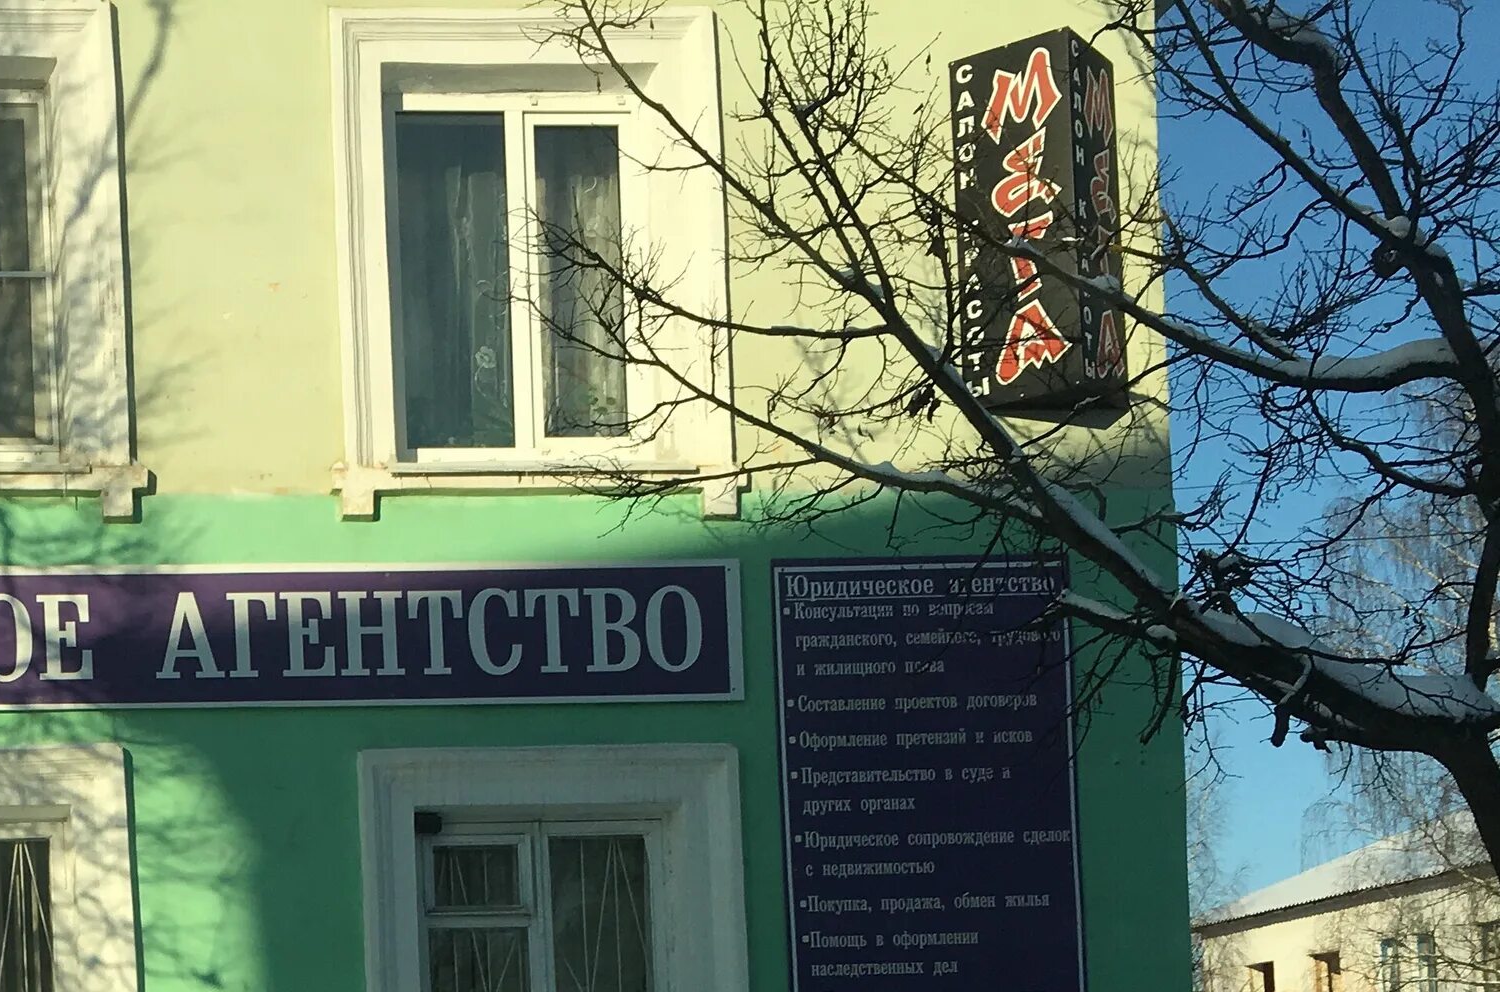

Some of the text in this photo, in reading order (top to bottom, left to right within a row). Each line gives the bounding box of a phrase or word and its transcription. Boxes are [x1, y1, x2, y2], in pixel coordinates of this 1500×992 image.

[1071, 39, 1096, 379] САЛОН КАОТЫ
[955, 64, 990, 397] САЛОН РАСОТЫ
[785, 575, 1056, 601] Юридическое аенство
[794, 602, 894, 622] Консультации
[902, 603, 920, 617] по
[155, 584, 704, 680] АГЕНТСТВО
[795, 633, 897, 651] гражданского,
[990, 630, 1061, 646] трудово
[796, 664, 805, 676] и
[814, 662, 896, 677] жилищного
[798, 695, 886, 712] Составление
[895, 696, 958, 713] проектов
[800, 727, 1033, 751] Оформление претензий и исков
[801, 767, 1011, 788] Представительство в суде и
[803, 798, 916, 816] других органах
[804, 829, 1071, 851] Юридическое сопровождение сделок
[805, 861, 935, 878] с недвижимостью
[807, 892, 1050, 915] Покупка, продажа, обмен жилья
[810, 931, 979, 950] Помощь в оформлении
[811, 960, 958, 977] наследственных дел
